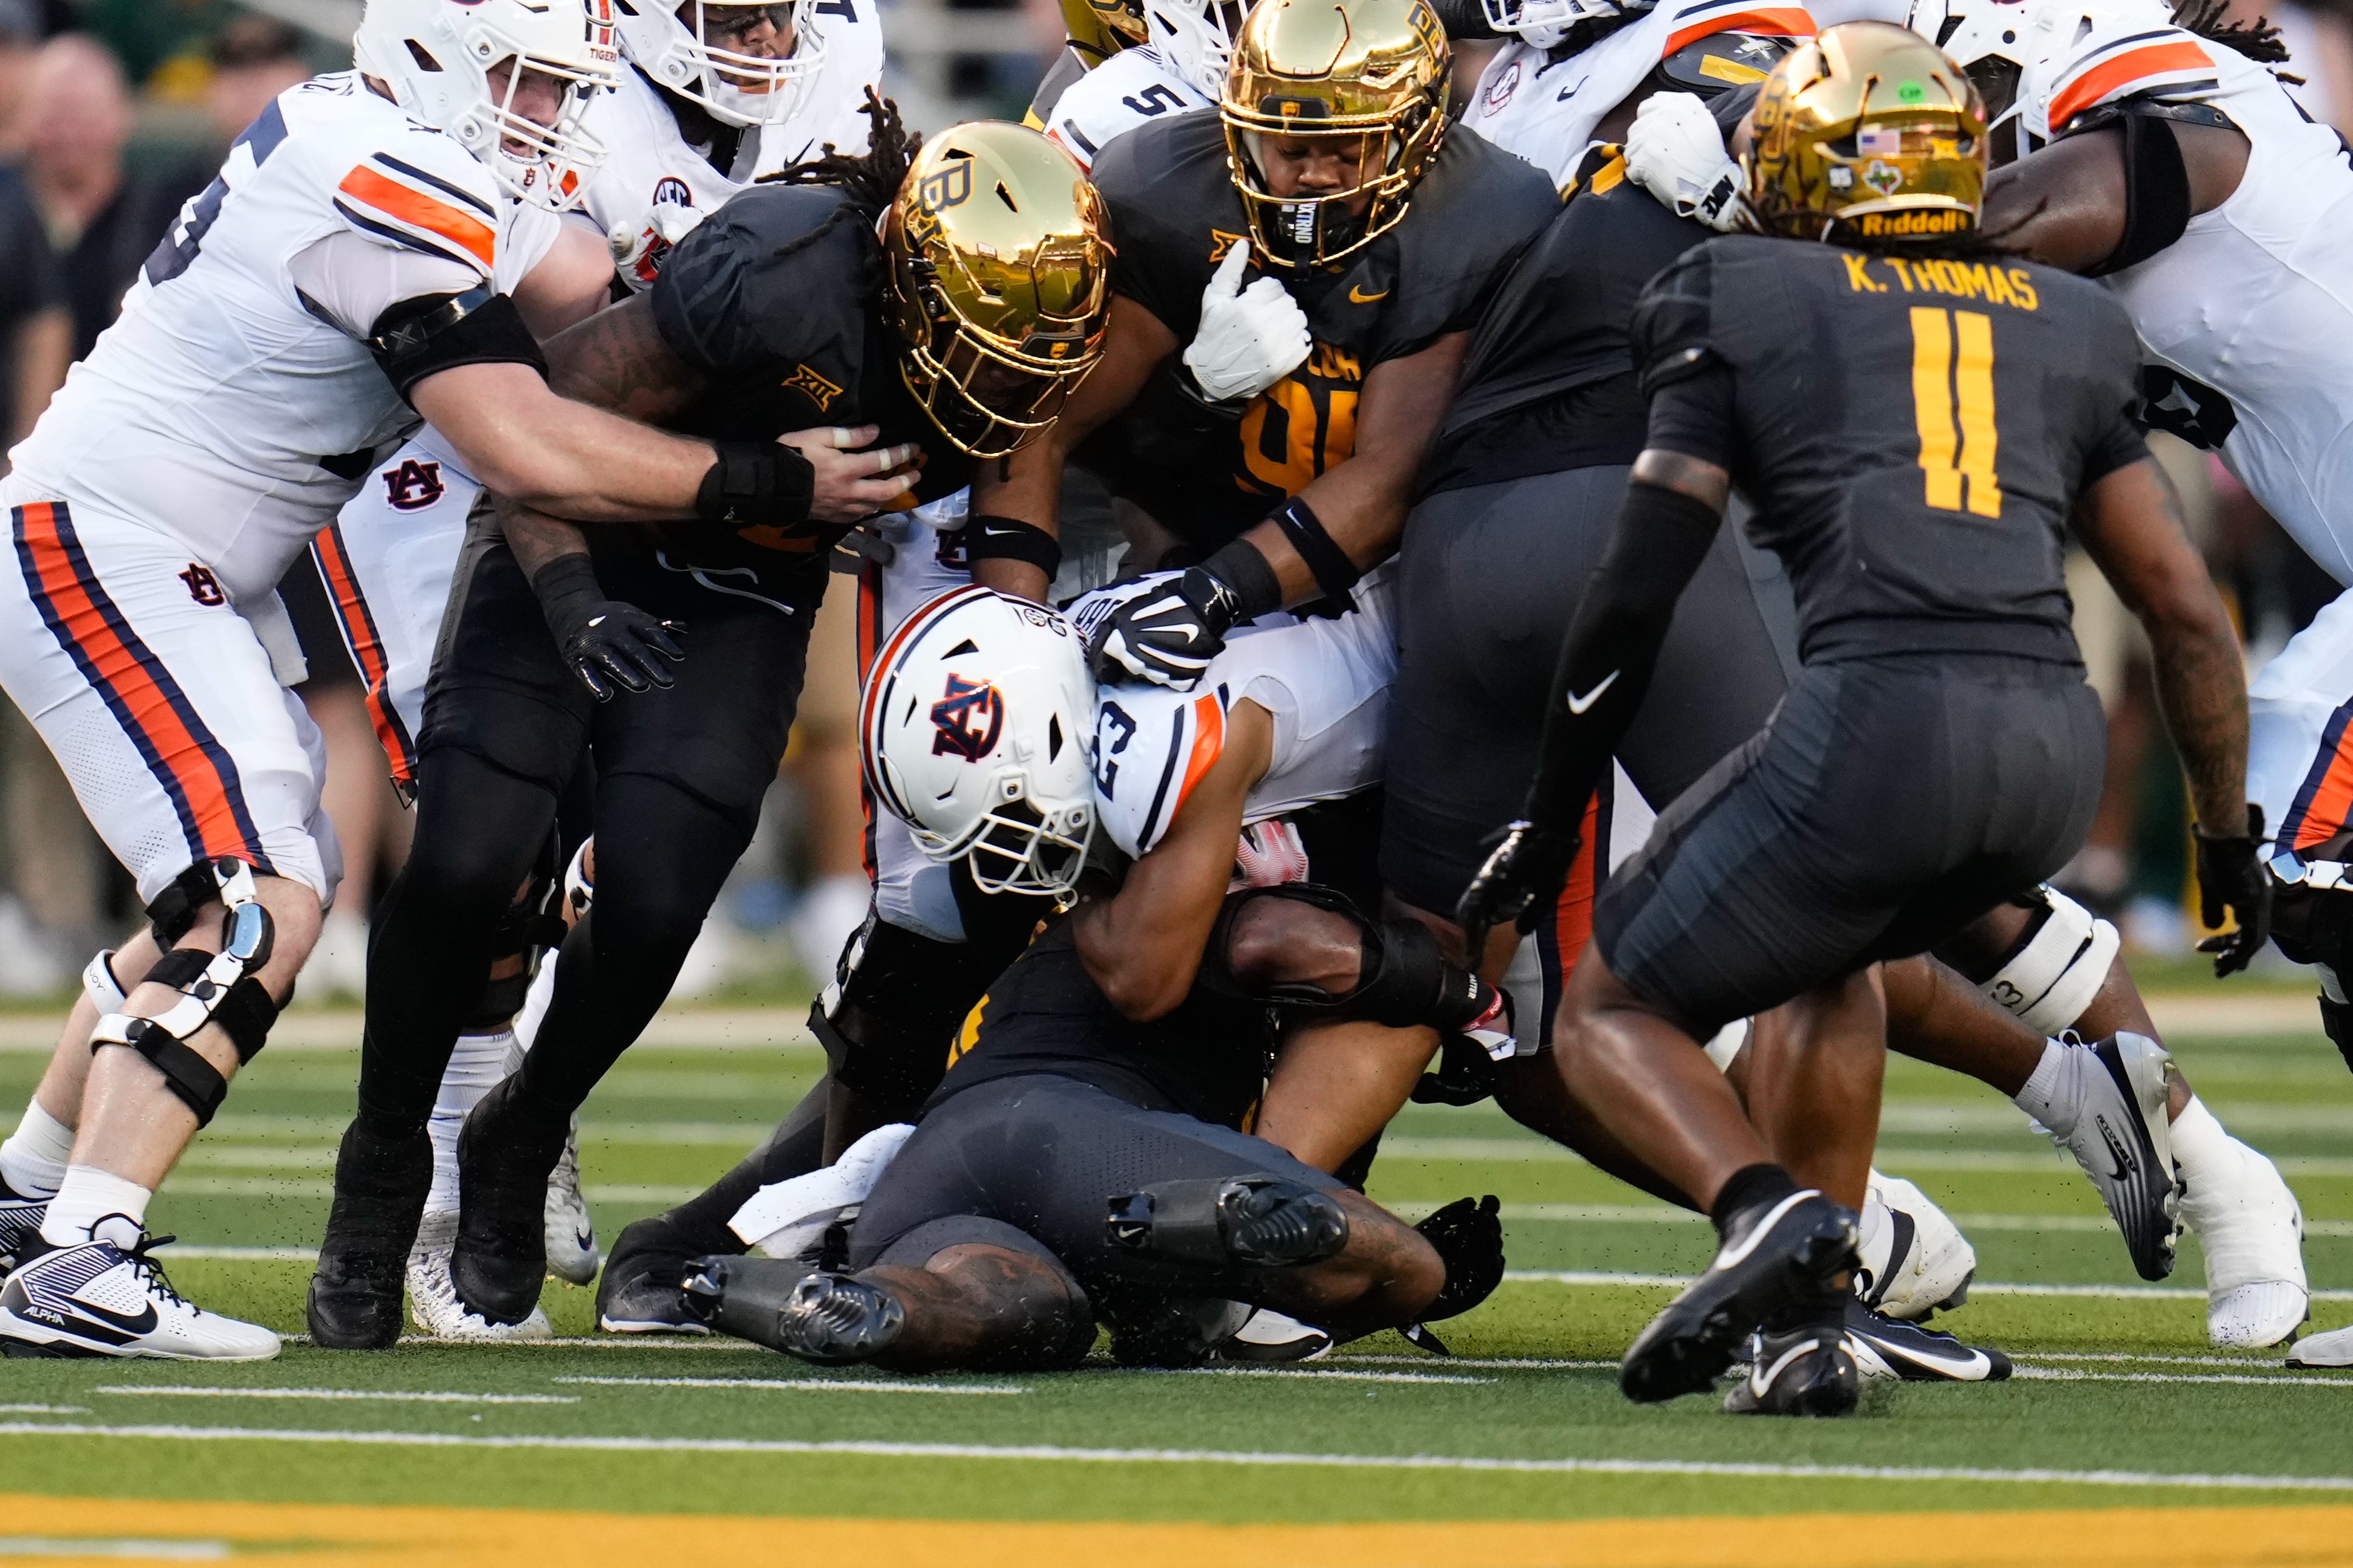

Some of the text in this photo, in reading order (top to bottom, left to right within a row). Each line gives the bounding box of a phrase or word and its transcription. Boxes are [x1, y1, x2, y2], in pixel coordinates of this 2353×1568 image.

[1122, 83, 1188, 116] 5
[1862, 209, 1958, 236] Riddell
[1841, 253, 2039, 311] K. THOMAS
[1909, 306, 2002, 519] 11
[22, 1306, 66, 1326] ALPHA
